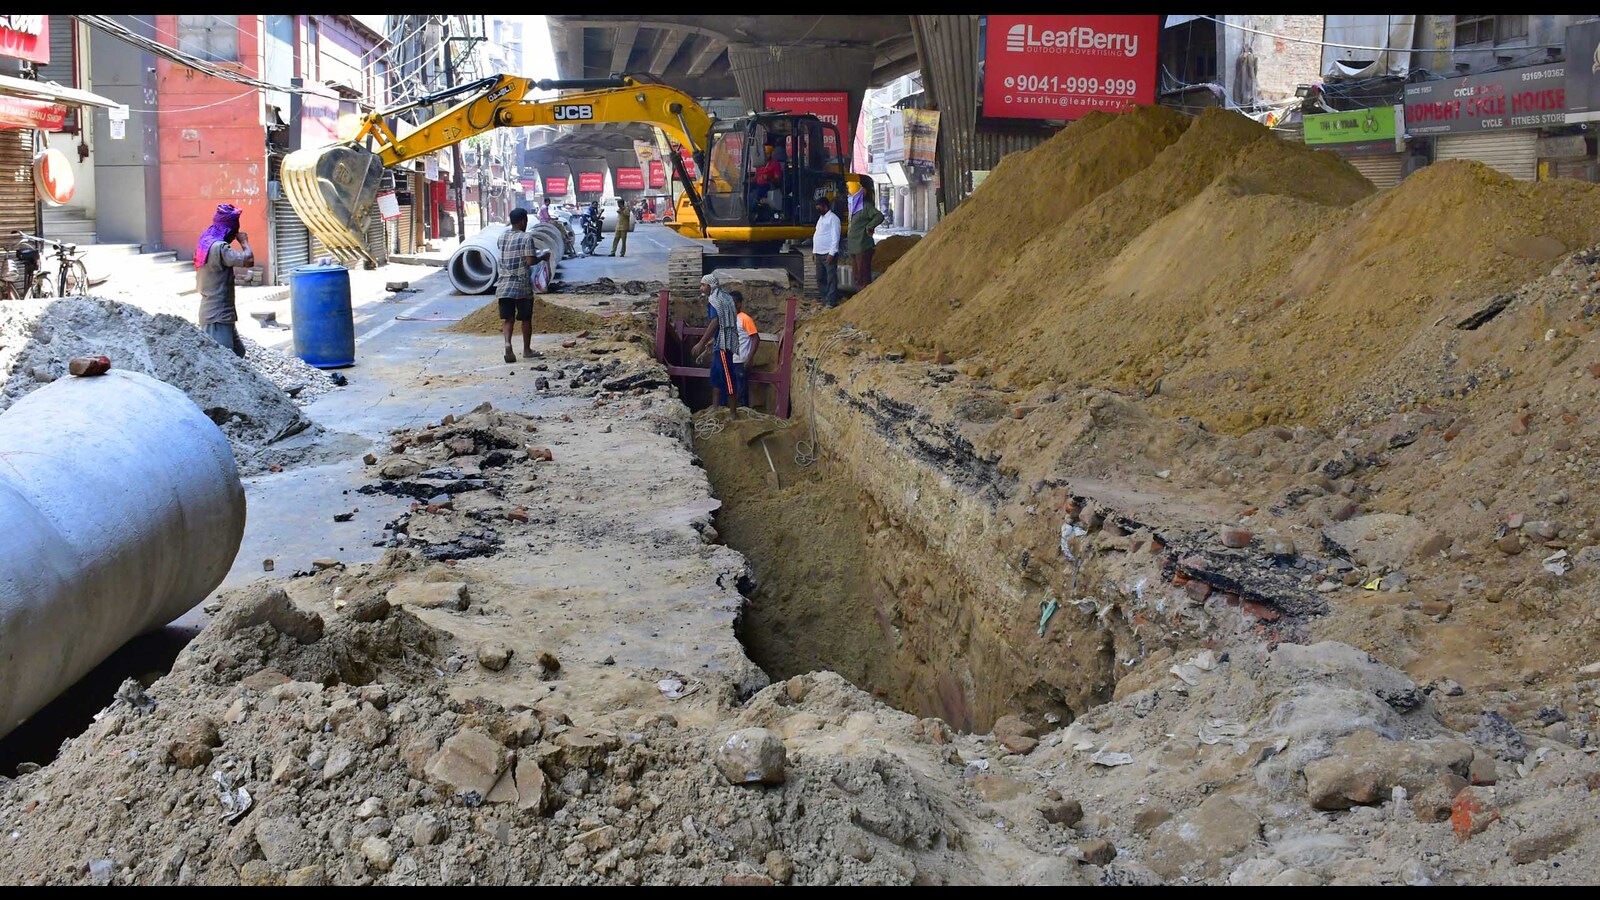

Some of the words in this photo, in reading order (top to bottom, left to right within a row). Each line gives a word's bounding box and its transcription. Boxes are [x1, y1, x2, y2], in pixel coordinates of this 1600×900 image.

[1027, 25, 1138, 57] LeafBerry
[1026, 45, 1067, 54] OUTDOOR
[1069, 48, 1123, 57] ADVERTISING
[1521, 69, 1565, 81] 93169-10362
[1017, 74, 1137, 95] 9041-999-999
[1453, 86, 1475, 98] CYCLE
[555, 105, 593, 120] JCB
[1407, 100, 1461, 122] BOMBAY
[1466, 94, 1506, 117] CYCLE
[1512, 88, 1566, 116] HOUSE
[30, 110, 46, 121] GANJ
[46, 113, 63, 123] SHOP
[1481, 118, 1503, 128] CYCLE
[1511, 115, 1540, 126] FITNESS
[1541, 113, 1566, 123] STORE
